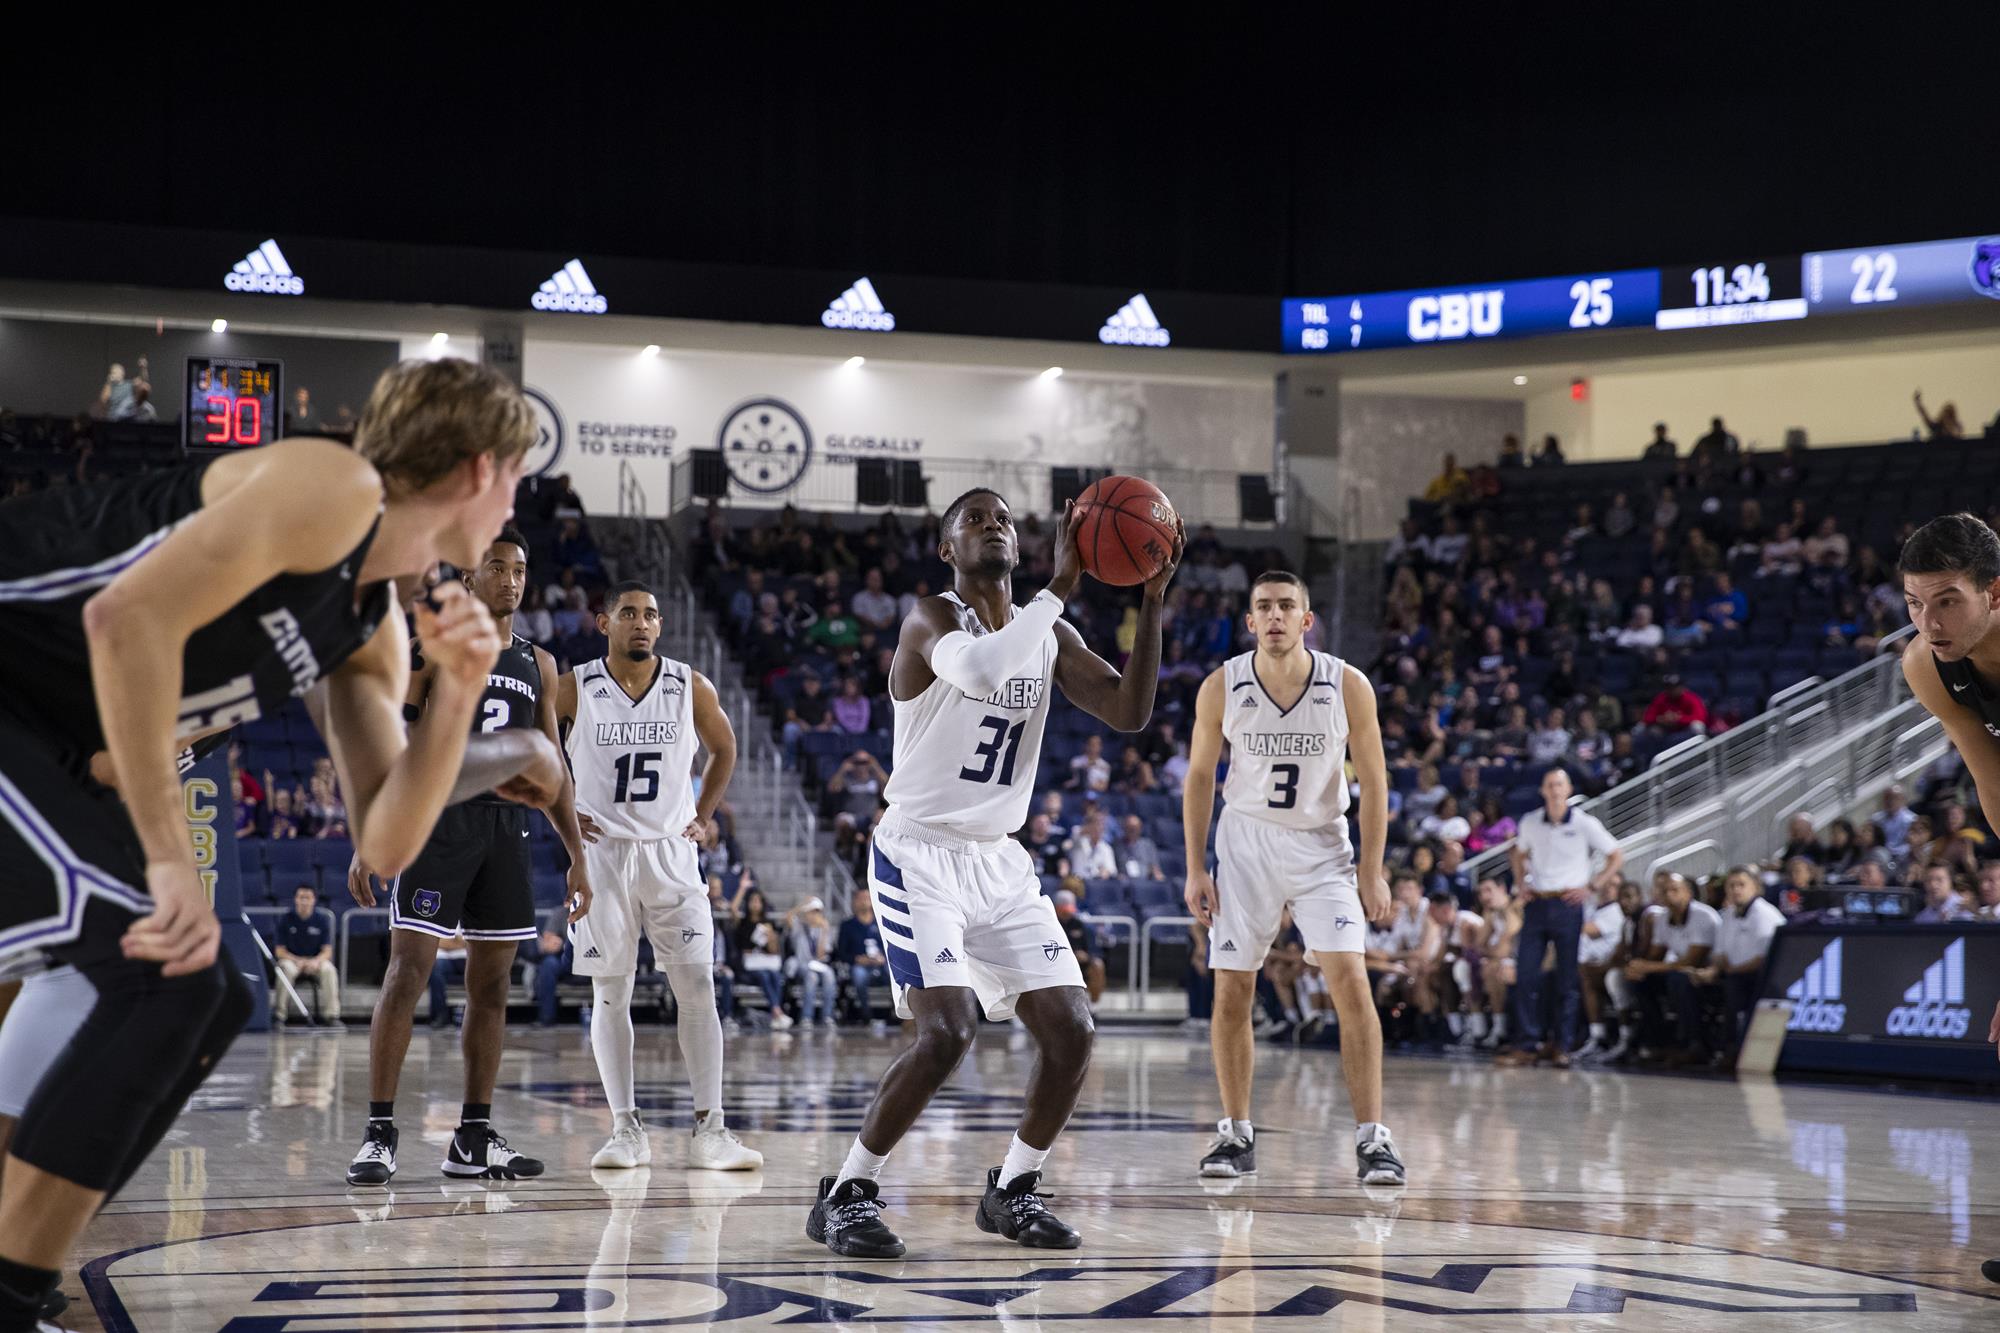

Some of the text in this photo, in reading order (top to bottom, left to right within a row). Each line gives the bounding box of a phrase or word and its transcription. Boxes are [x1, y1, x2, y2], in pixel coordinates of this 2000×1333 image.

[224, 272, 304, 295] adidas
[1691, 262, 1770, 306] 11:34
[1851, 252, 1898, 304] 22
[531, 291, 608, 314] adidas
[1408, 290, 1504, 342] CBU
[1569, 278, 1613, 327] 25
[821, 309, 895, 331] adidas
[206, 396, 261, 445] 30
[578, 423, 677, 439] EQUIPPED
[579, 440, 672, 456] TO SERVE
[825, 434, 923, 452] GLOBALLY
[662, 688, 681, 696] WAC
[1312, 697, 1331, 705] WAC
[597, 722, 677, 746] LANCERS
[1243, 733, 1325, 756] LANCERS
[959, 715, 1026, 786] 31
[614, 752, 662, 802] 15
[1268, 763, 1300, 809] 3
[1786, 996, 1847, 1033] didas
[1886, 1000, 1971, 1039] adidas
